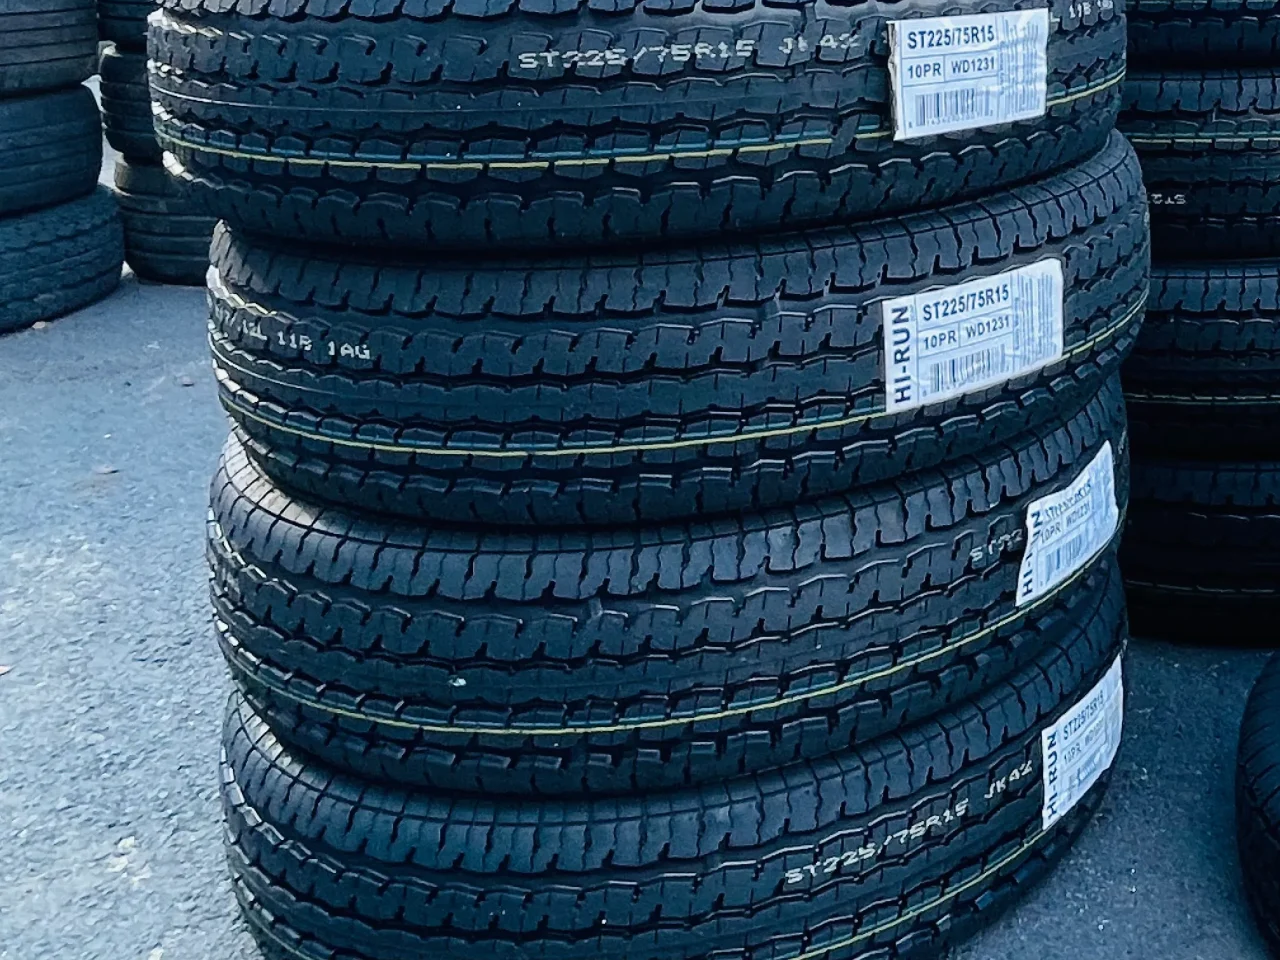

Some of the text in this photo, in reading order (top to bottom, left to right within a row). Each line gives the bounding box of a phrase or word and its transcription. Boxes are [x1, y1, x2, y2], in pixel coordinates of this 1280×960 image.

[907, 25, 995, 50] ST225/75R15
[907, 56, 995, 79] 10PR WD1231
[922, 284, 1010, 321] ST225/75R15
[923, 315, 1011, 350] 10PR WD1231
[891, 306, 911, 404] HI-RUN
[1047, 728, 1058, 821] HI-RUN
